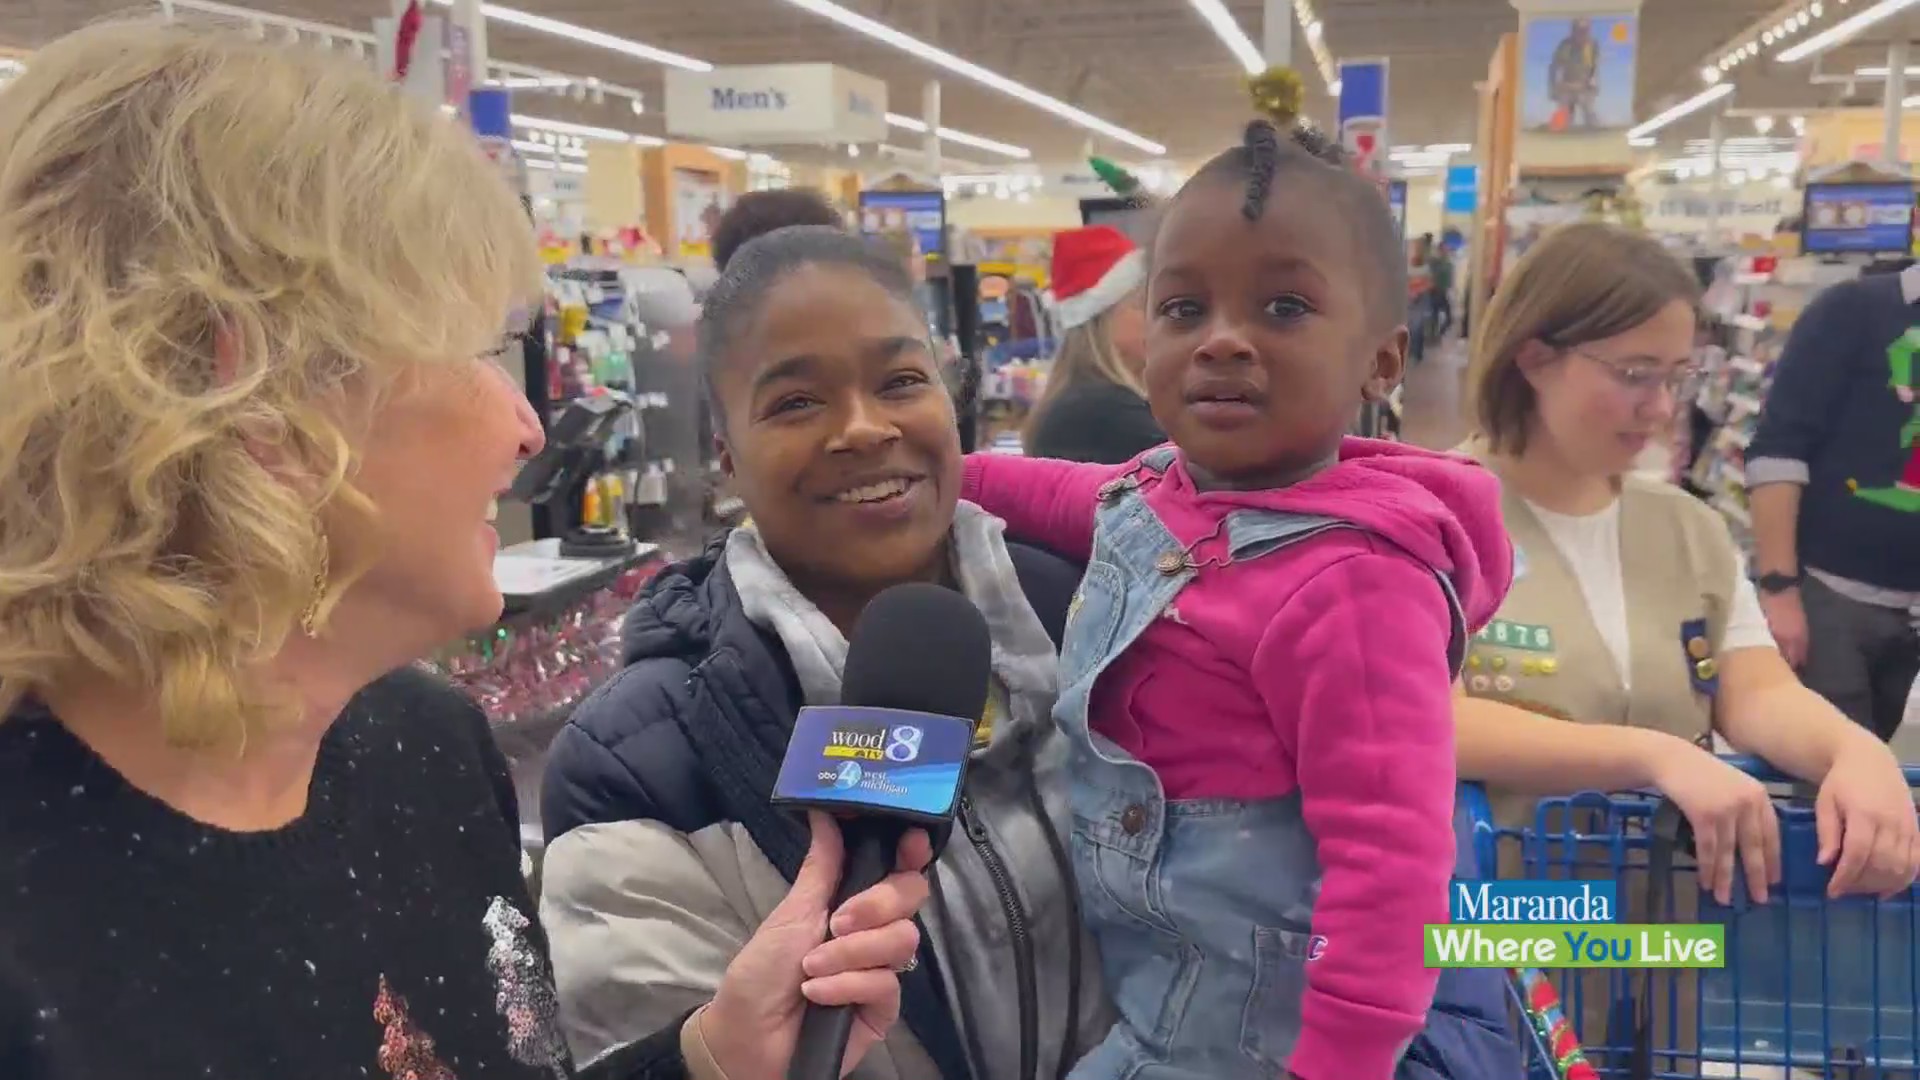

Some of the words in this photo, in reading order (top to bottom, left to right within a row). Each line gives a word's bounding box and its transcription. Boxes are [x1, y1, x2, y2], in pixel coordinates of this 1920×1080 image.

[711, 87, 787, 111] Men's
[831, 729, 886, 749] wood
[885, 725, 921, 762] 8
[863, 770, 886, 780] west
[860, 779, 910, 795] michigan
